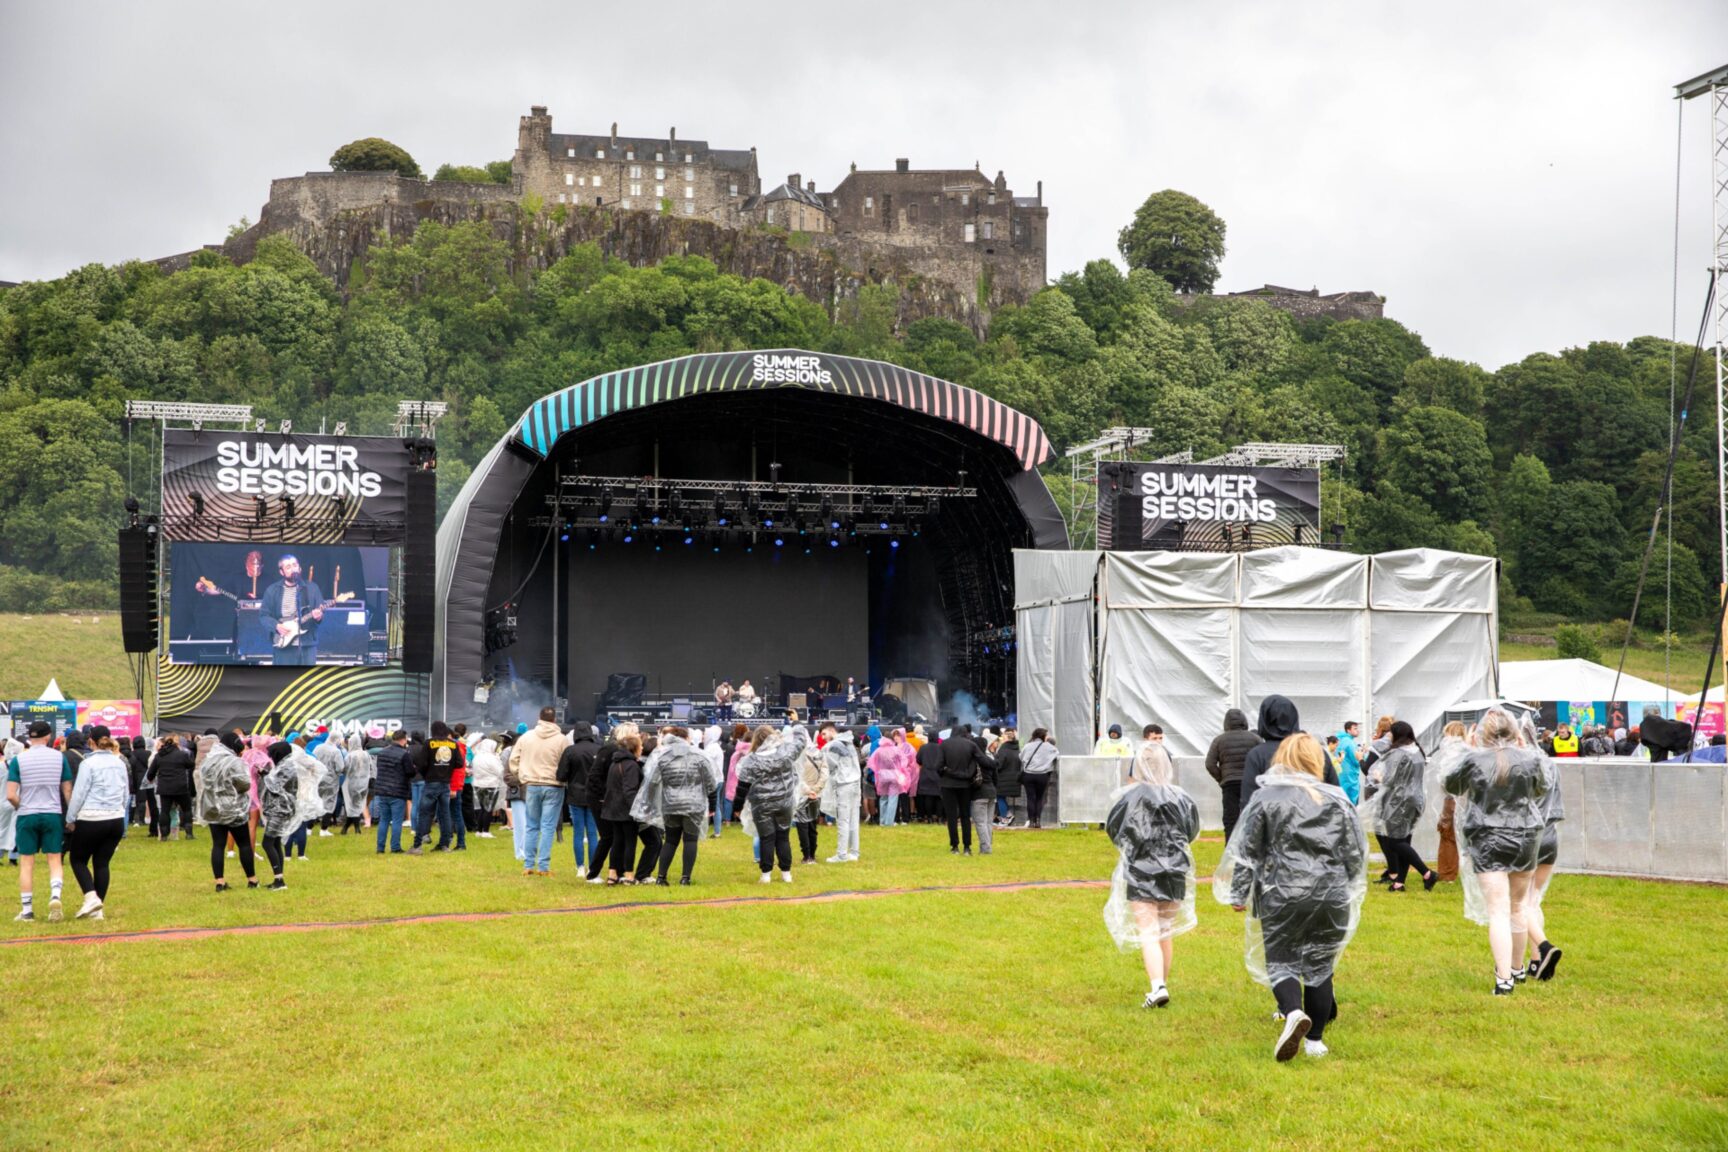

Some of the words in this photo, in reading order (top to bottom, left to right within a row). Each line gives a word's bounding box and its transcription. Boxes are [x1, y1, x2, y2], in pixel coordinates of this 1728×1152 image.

[753, 354, 820, 370] SUMMER
[753, 368, 832, 384] SESSIONS
[217, 441, 359, 471] SUMMER
[216, 467, 382, 497] SESSIONS
[1141, 472, 1258, 498] SUMMER
[1142, 496, 1277, 522] SESSIONS
